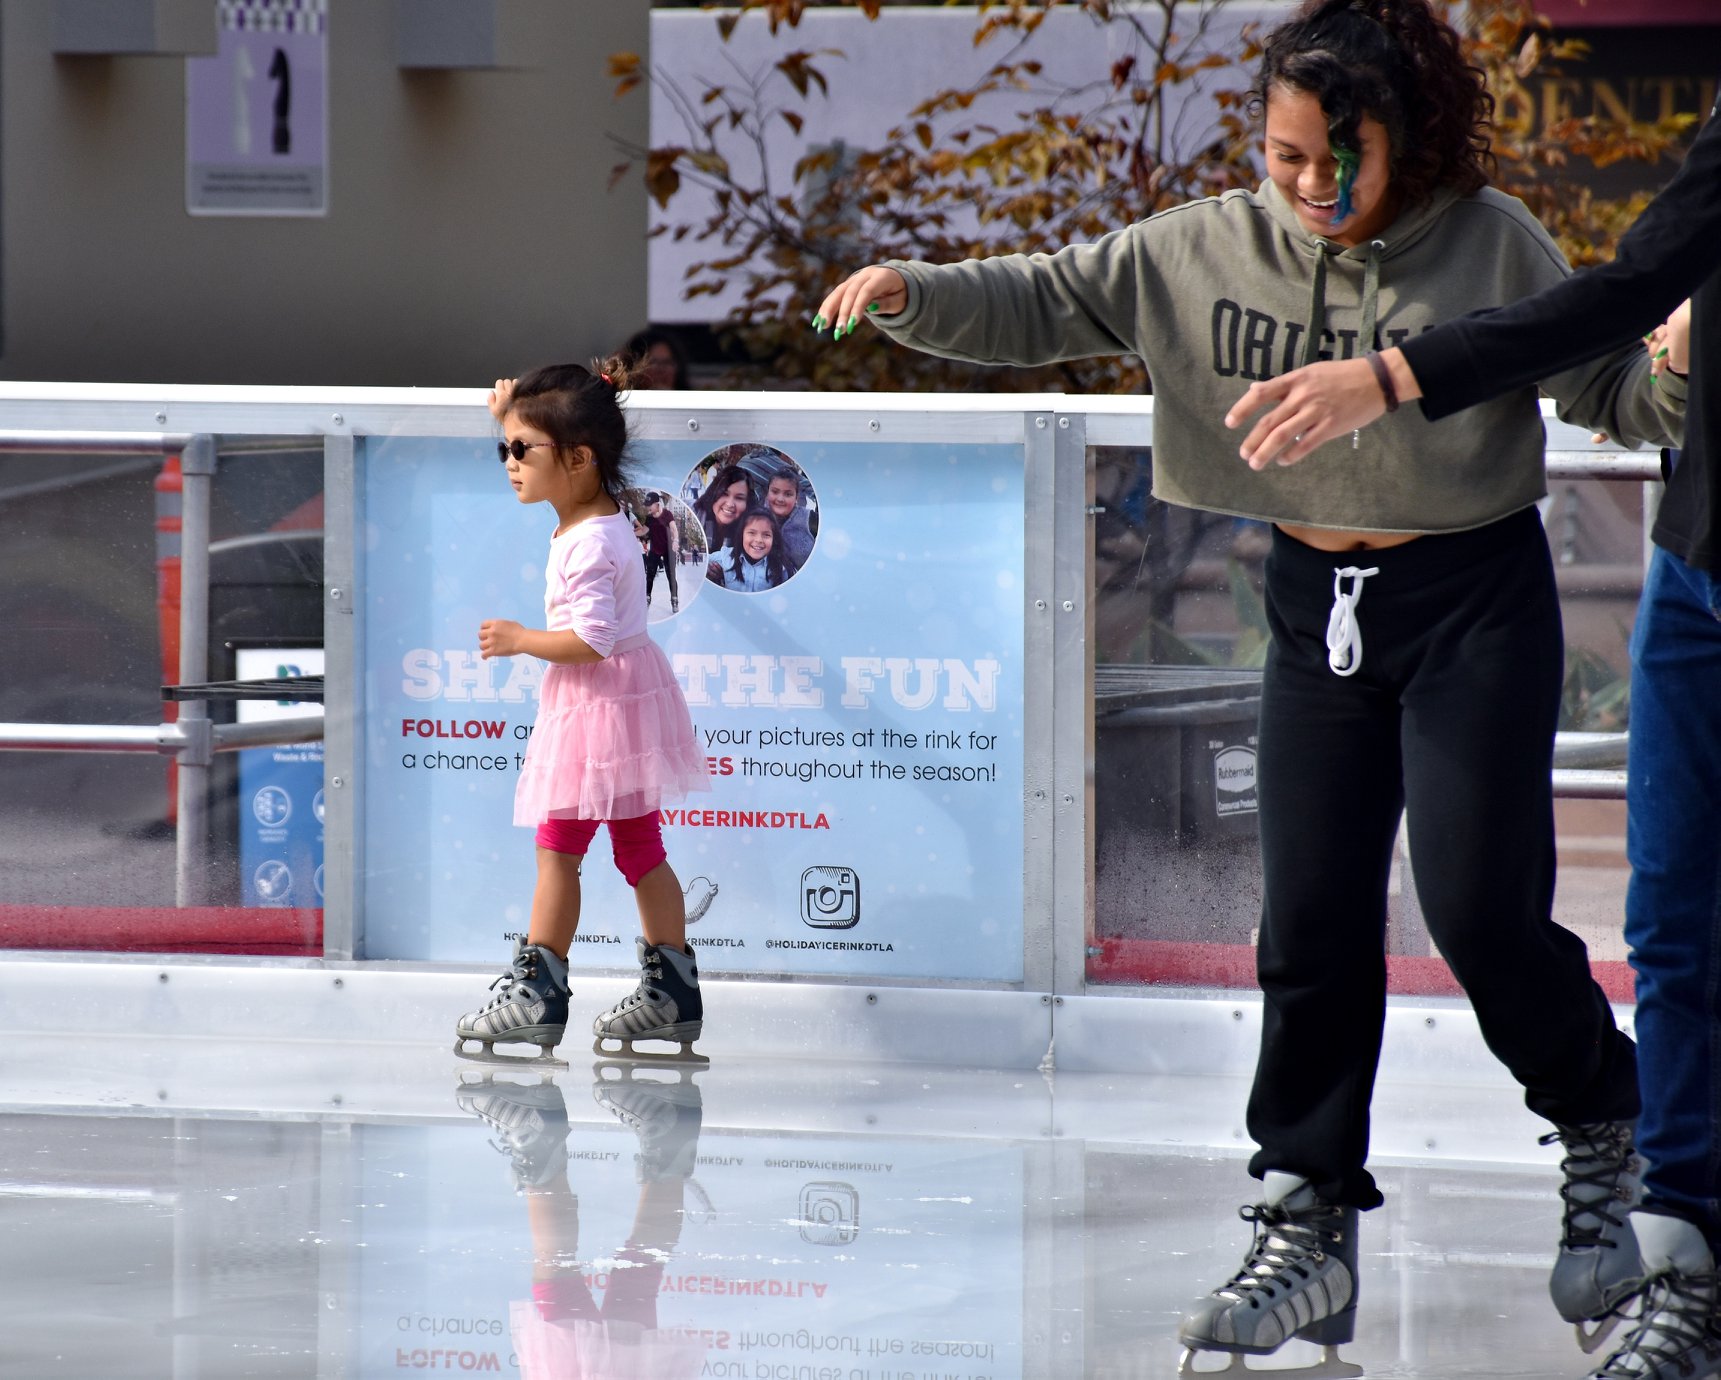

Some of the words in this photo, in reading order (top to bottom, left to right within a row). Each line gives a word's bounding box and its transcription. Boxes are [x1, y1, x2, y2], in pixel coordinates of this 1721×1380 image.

[402, 649, 545, 703] SHA
[672, 654, 824, 709] THE
[841, 657, 1000, 712] FUN
[402, 719, 506, 739] FOLLOW
[704, 729, 752, 748] your
[760, 727, 845, 749] pictures
[852, 729, 874, 748] at
[881, 730, 917, 749] the
[925, 730, 961, 750] rink
[968, 731, 998, 750] for
[402, 753, 416, 769] a
[423, 750, 508, 770] chance
[741, 757, 864, 782] throughout
[870, 759, 906, 780] the
[912, 763, 996, 782] season!
[1218, 765, 1254, 780] Rubbermaid
[658, 809, 830, 830] AYICERINKDTLA
[765, 940, 894, 952] @HOLIDAYICERINKDTLA
